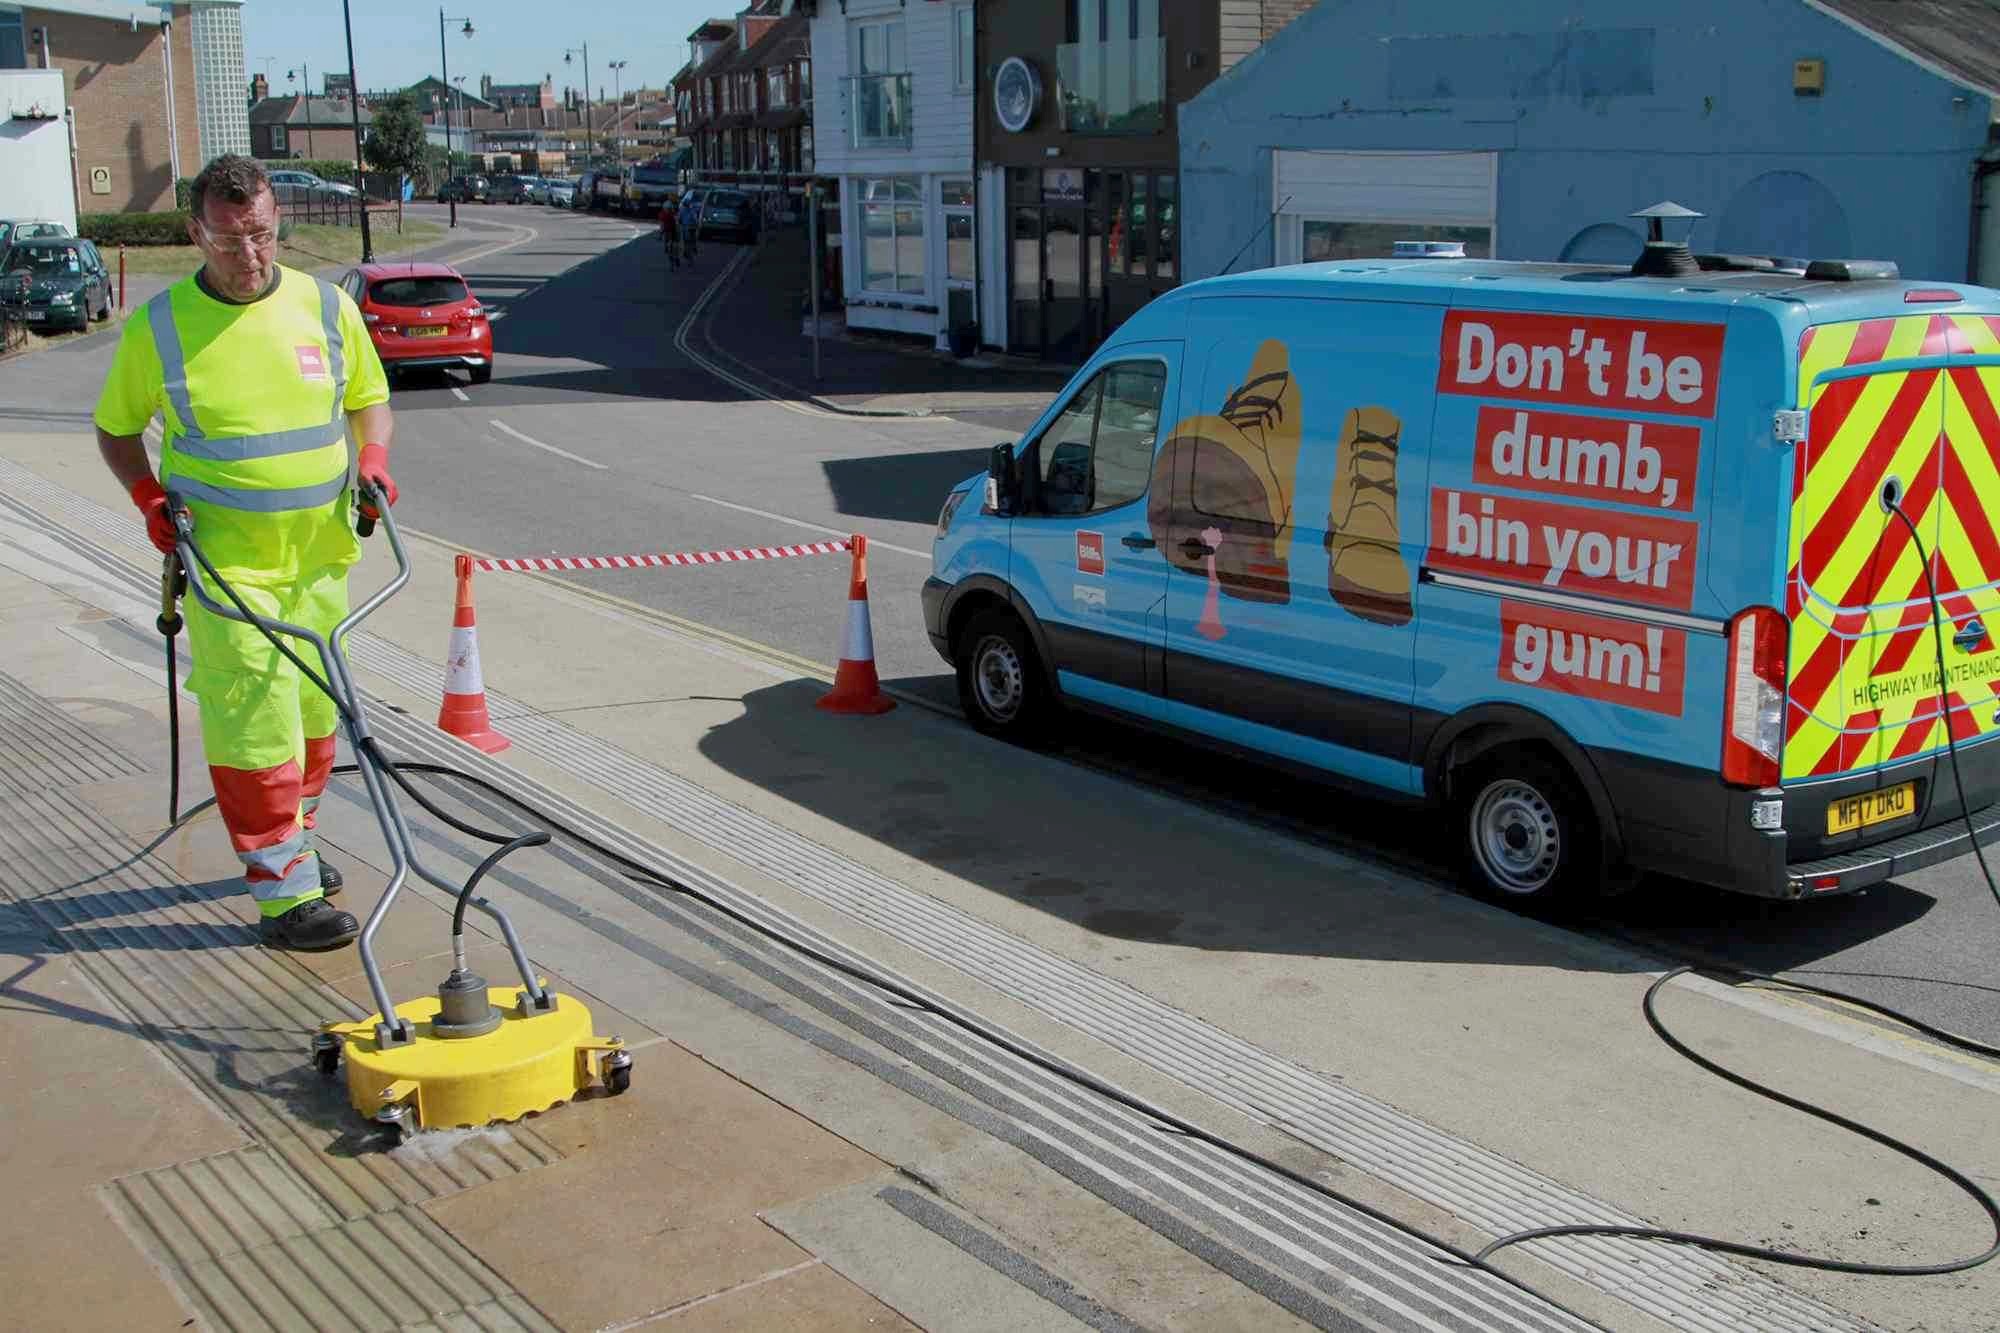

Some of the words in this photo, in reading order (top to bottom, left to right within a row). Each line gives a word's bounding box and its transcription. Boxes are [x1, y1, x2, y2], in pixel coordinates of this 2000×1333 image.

[1455, 321, 1612, 397] Don't
[1624, 330, 1704, 404] be
[1491, 411, 1679, 507] dumb,
[1446, 492, 1529, 568] bin
[1541, 524, 1681, 589] your
[1511, 621, 1664, 693] gum!
[1853, 674, 1918, 706] HIGHWAY
[1922, 655, 2000, 690] MANTENANC
[1839, 797, 1872, 825] MF17
[1877, 788, 1904, 815] DKO
